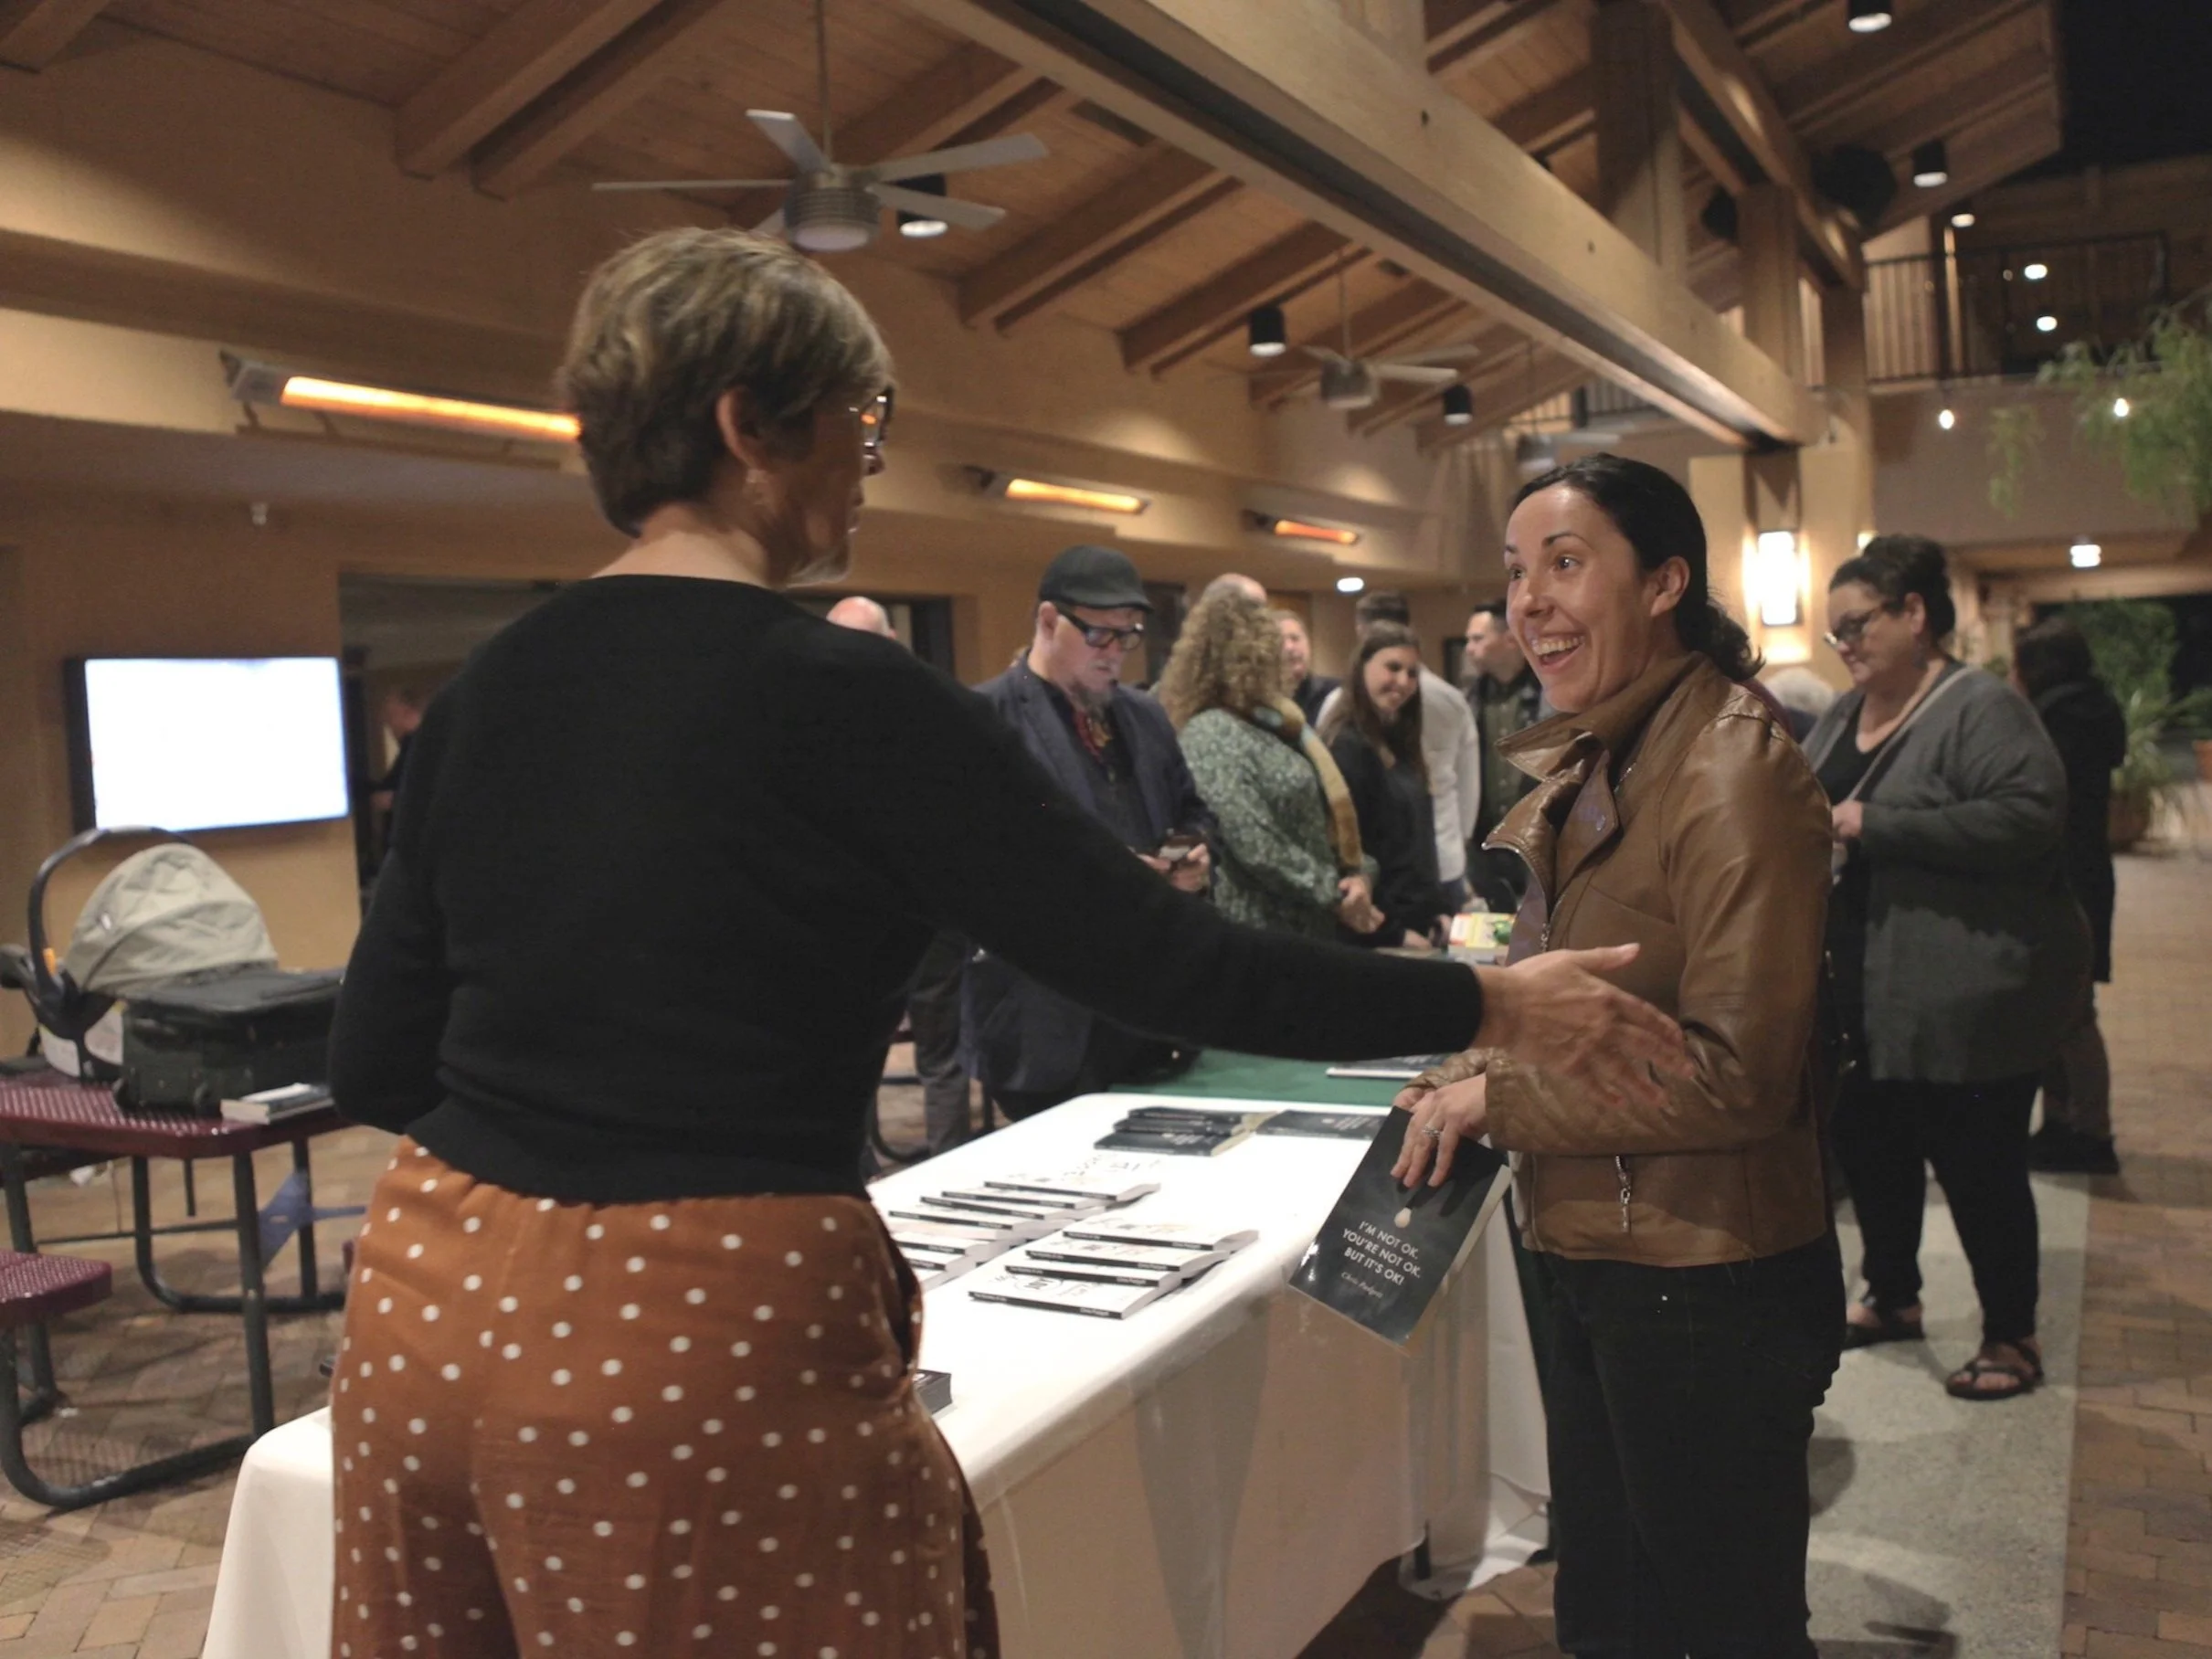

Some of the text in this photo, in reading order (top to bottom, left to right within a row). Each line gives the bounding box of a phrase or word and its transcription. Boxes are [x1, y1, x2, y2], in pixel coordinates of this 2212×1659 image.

[1342, 1228, 1380, 1254] YOU'RE
[1379, 1249, 1403, 1266] NOT
[1377, 1231, 1402, 1248] NOT
[1344, 1246, 1405, 1285] BUT IT'S OK!
